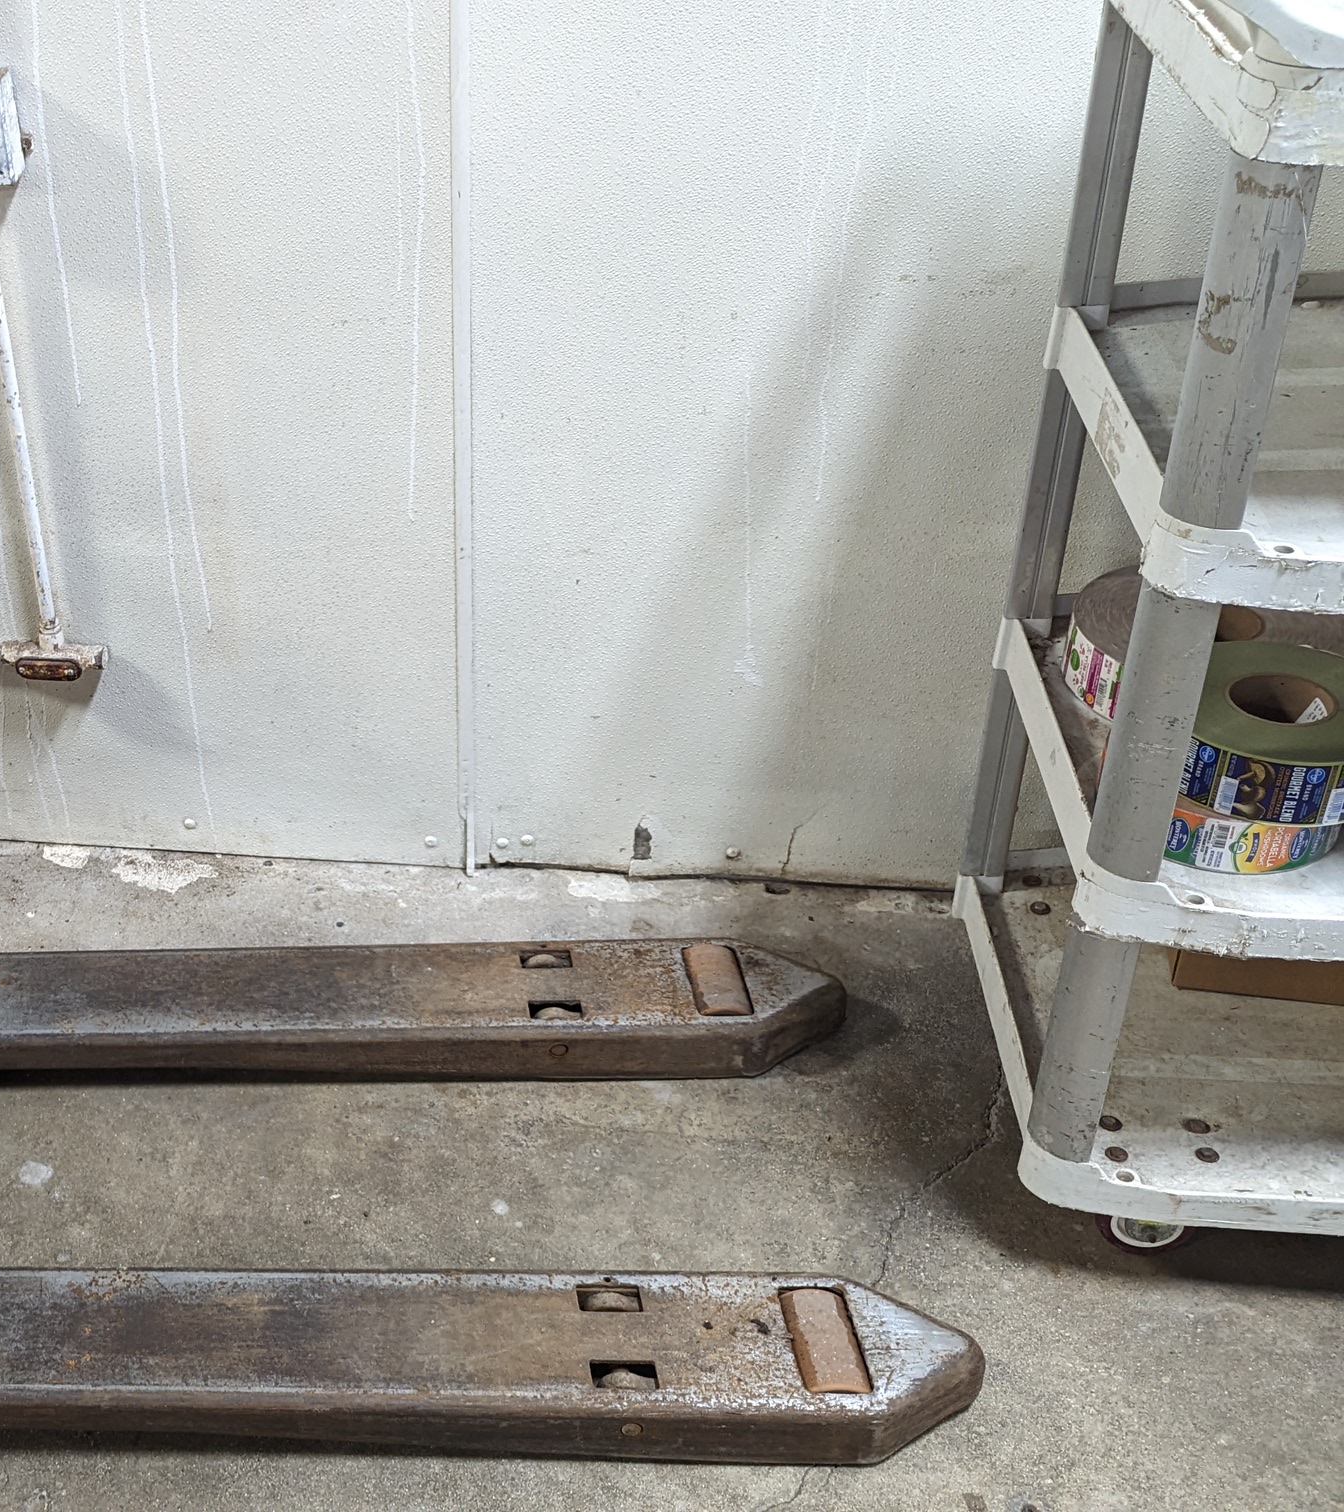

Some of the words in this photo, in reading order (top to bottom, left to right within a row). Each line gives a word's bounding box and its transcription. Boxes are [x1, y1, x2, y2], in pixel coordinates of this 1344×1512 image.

[1285, 767, 1306, 799] GOURMET
[1302, 784, 1312, 801] BRAND
[1279, 800, 1296, 822] BLEND
[1169, 821, 1181, 849] MONTEREY
[1250, 838, 1258, 857] WHOLE
[1257, 830, 1272, 866] MUSHROOMS
[1266, 827, 1285, 868] PORTABELLA
[1278, 833, 1291, 859] ORGANIC
[1293, 831, 1306, 859] MONTEREY
